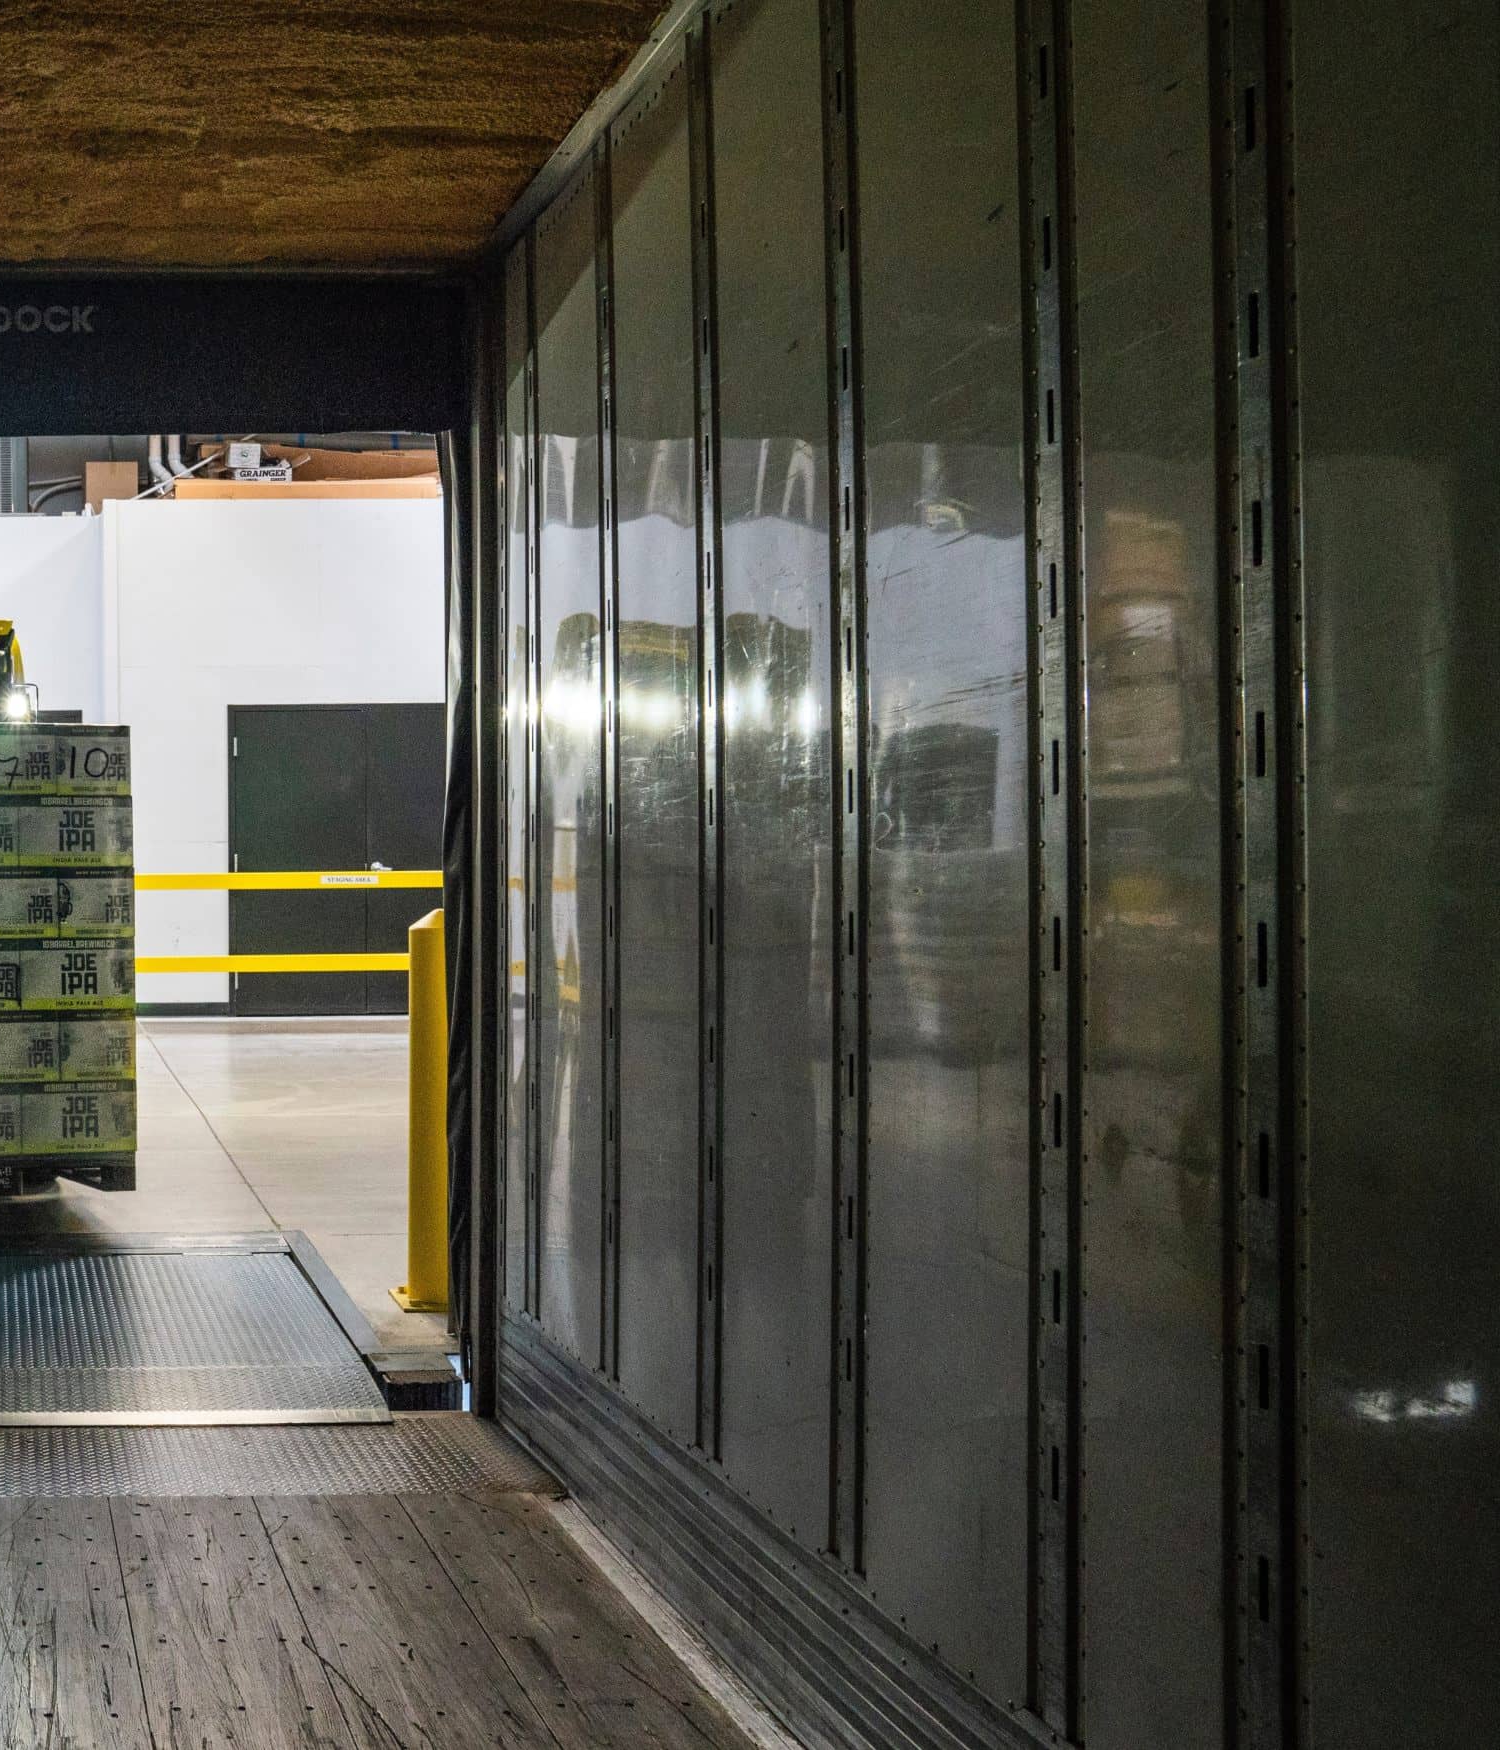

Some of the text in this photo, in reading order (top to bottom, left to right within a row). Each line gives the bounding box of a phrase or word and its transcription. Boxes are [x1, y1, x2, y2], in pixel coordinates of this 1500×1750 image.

[240, 469, 287, 477] GRAINGER
[26, 752, 50, 764] JOE
[107, 753, 126, 765] OE
[26, 765, 51, 779] IPA
[59, 810, 95, 828] JOE
[59, 829, 95, 851] IPA
[28, 895, 52, 907] JOE
[106, 895, 130, 907] JOE
[28, 908, 53, 923] IPA
[105, 908, 130, 923] IPA
[61, 953, 97, 971] JOE
[61, 973, 97, 994] IPA
[29, 1039, 53, 1051] JOE
[106, 1037, 130, 1050] JOE
[29, 1052, 54, 1067] IPA
[62, 1096, 98, 1114] JOE
[62, 1115, 98, 1138] IPA
